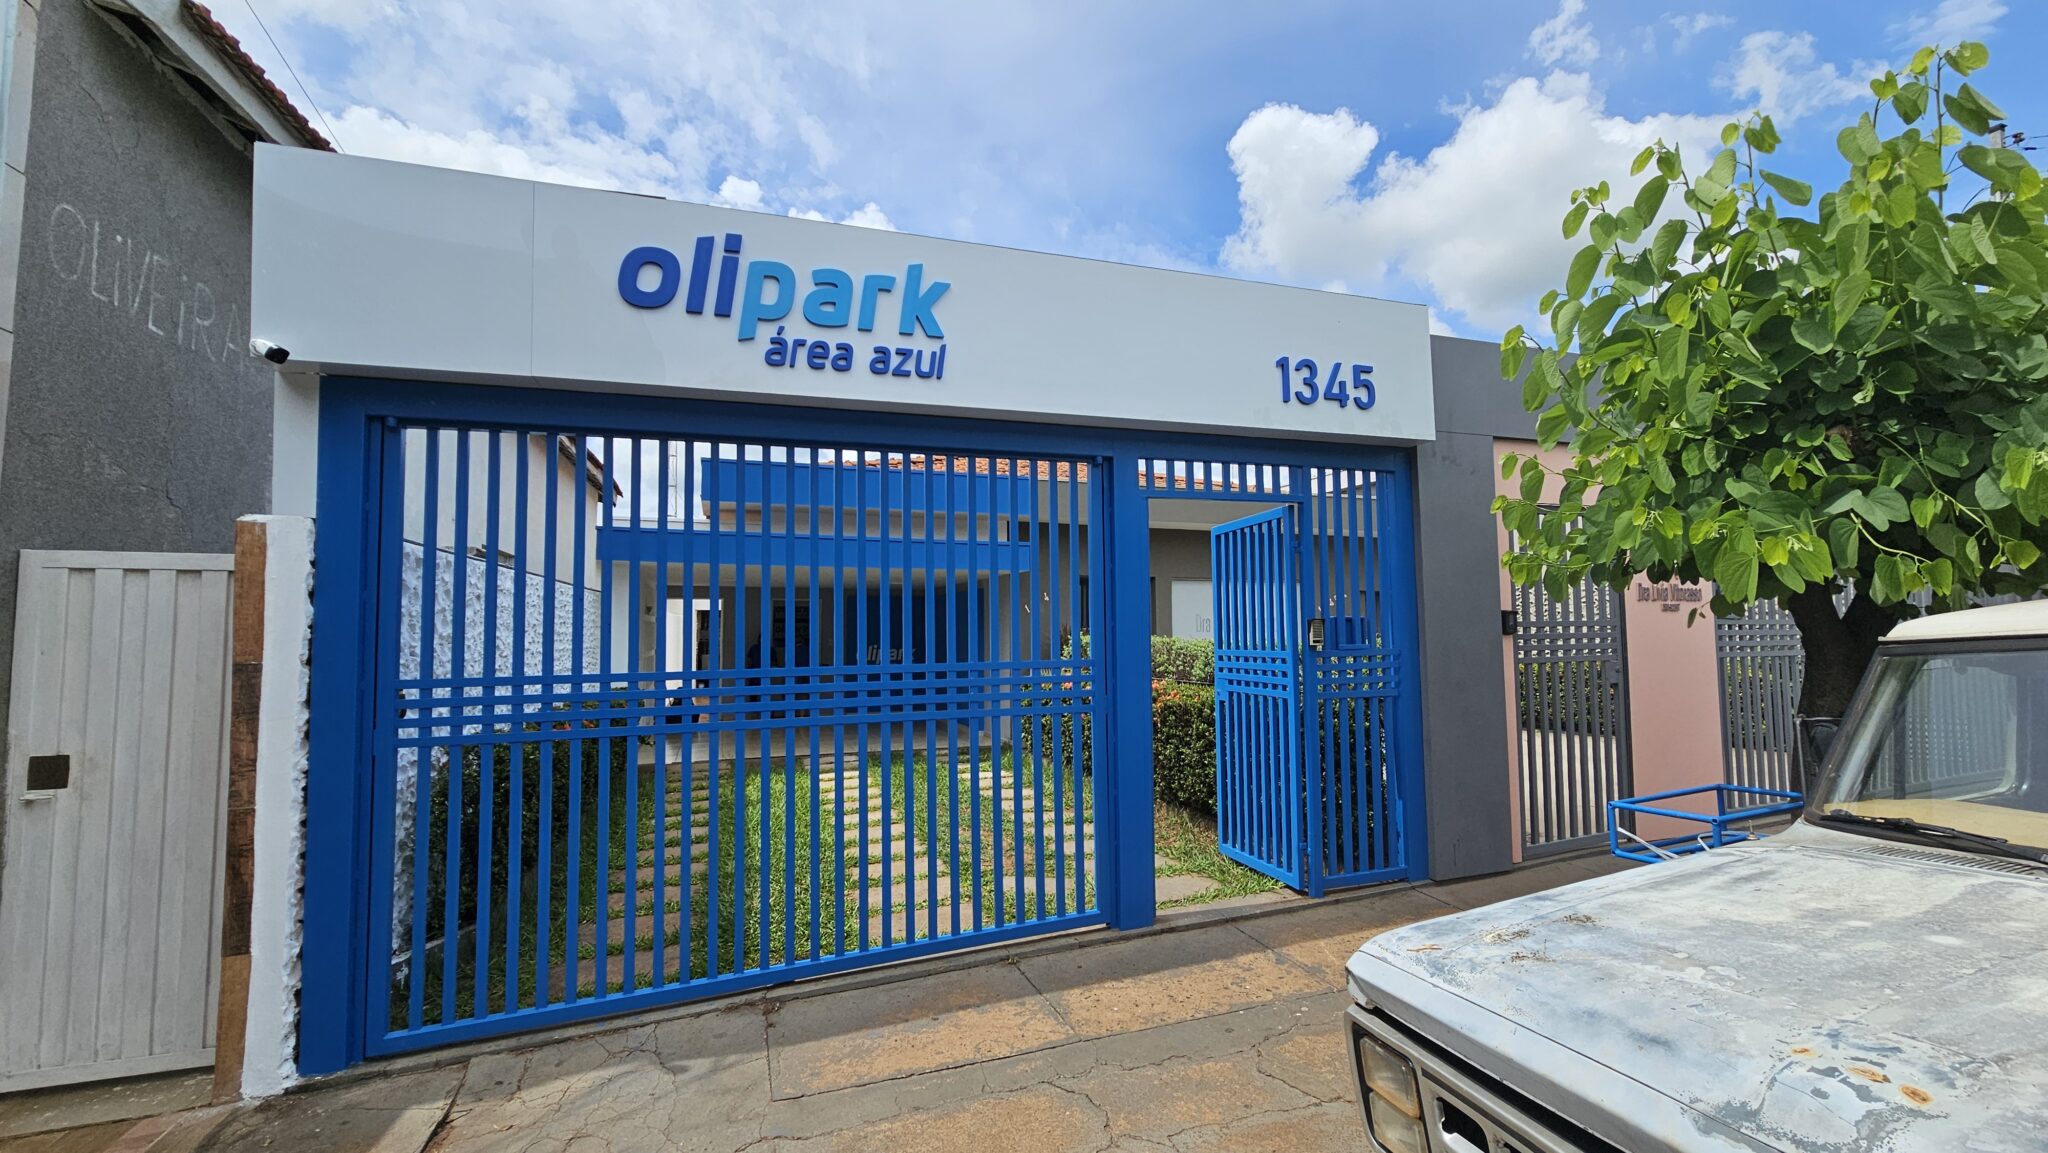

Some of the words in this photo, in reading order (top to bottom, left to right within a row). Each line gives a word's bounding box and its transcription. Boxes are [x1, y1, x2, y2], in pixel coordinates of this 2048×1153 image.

[617, 232, 951, 341] olipark
[764, 325, 854, 372] área
[869, 343, 947, 379] azul
[1275, 356, 1376, 410] 1345
[1195, 614, 1211, 633] Dra
